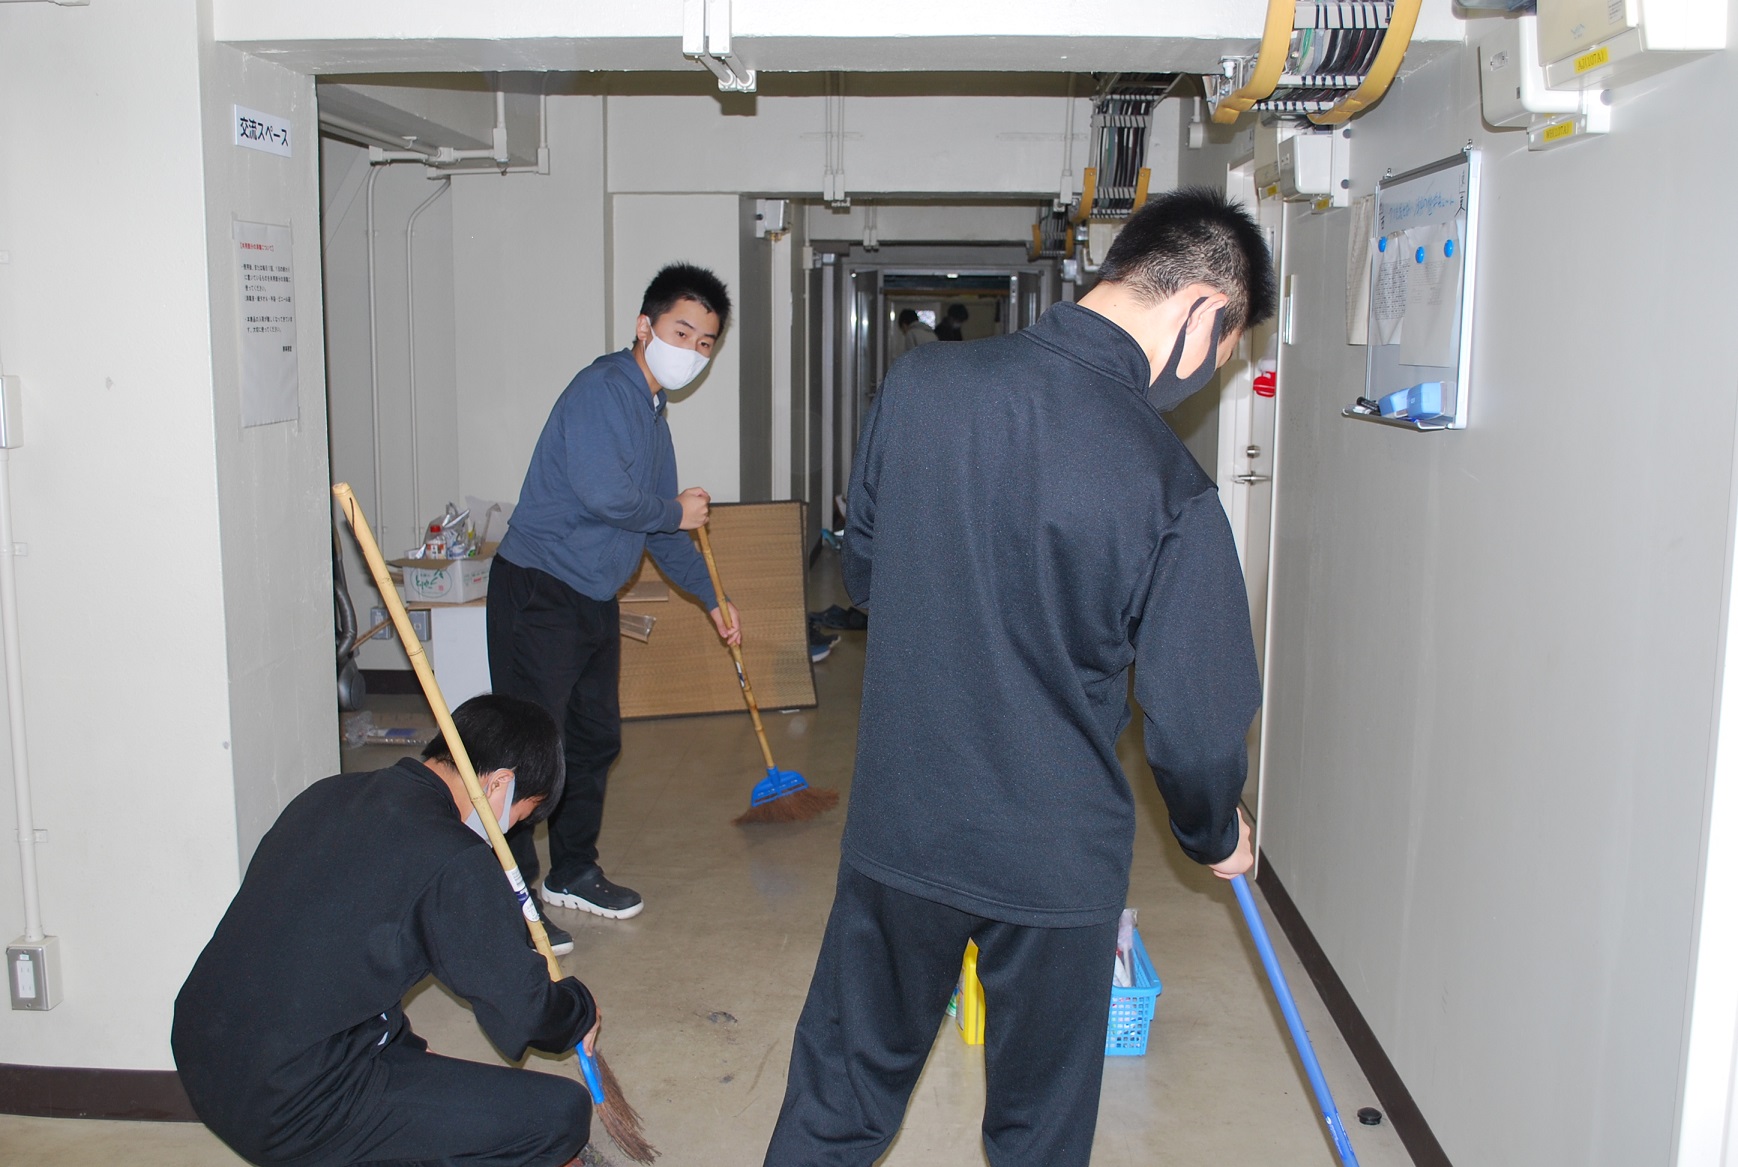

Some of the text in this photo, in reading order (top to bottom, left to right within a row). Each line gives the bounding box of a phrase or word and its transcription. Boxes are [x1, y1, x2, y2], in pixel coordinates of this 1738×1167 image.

[240, 117, 289, 147] 交流スペース
